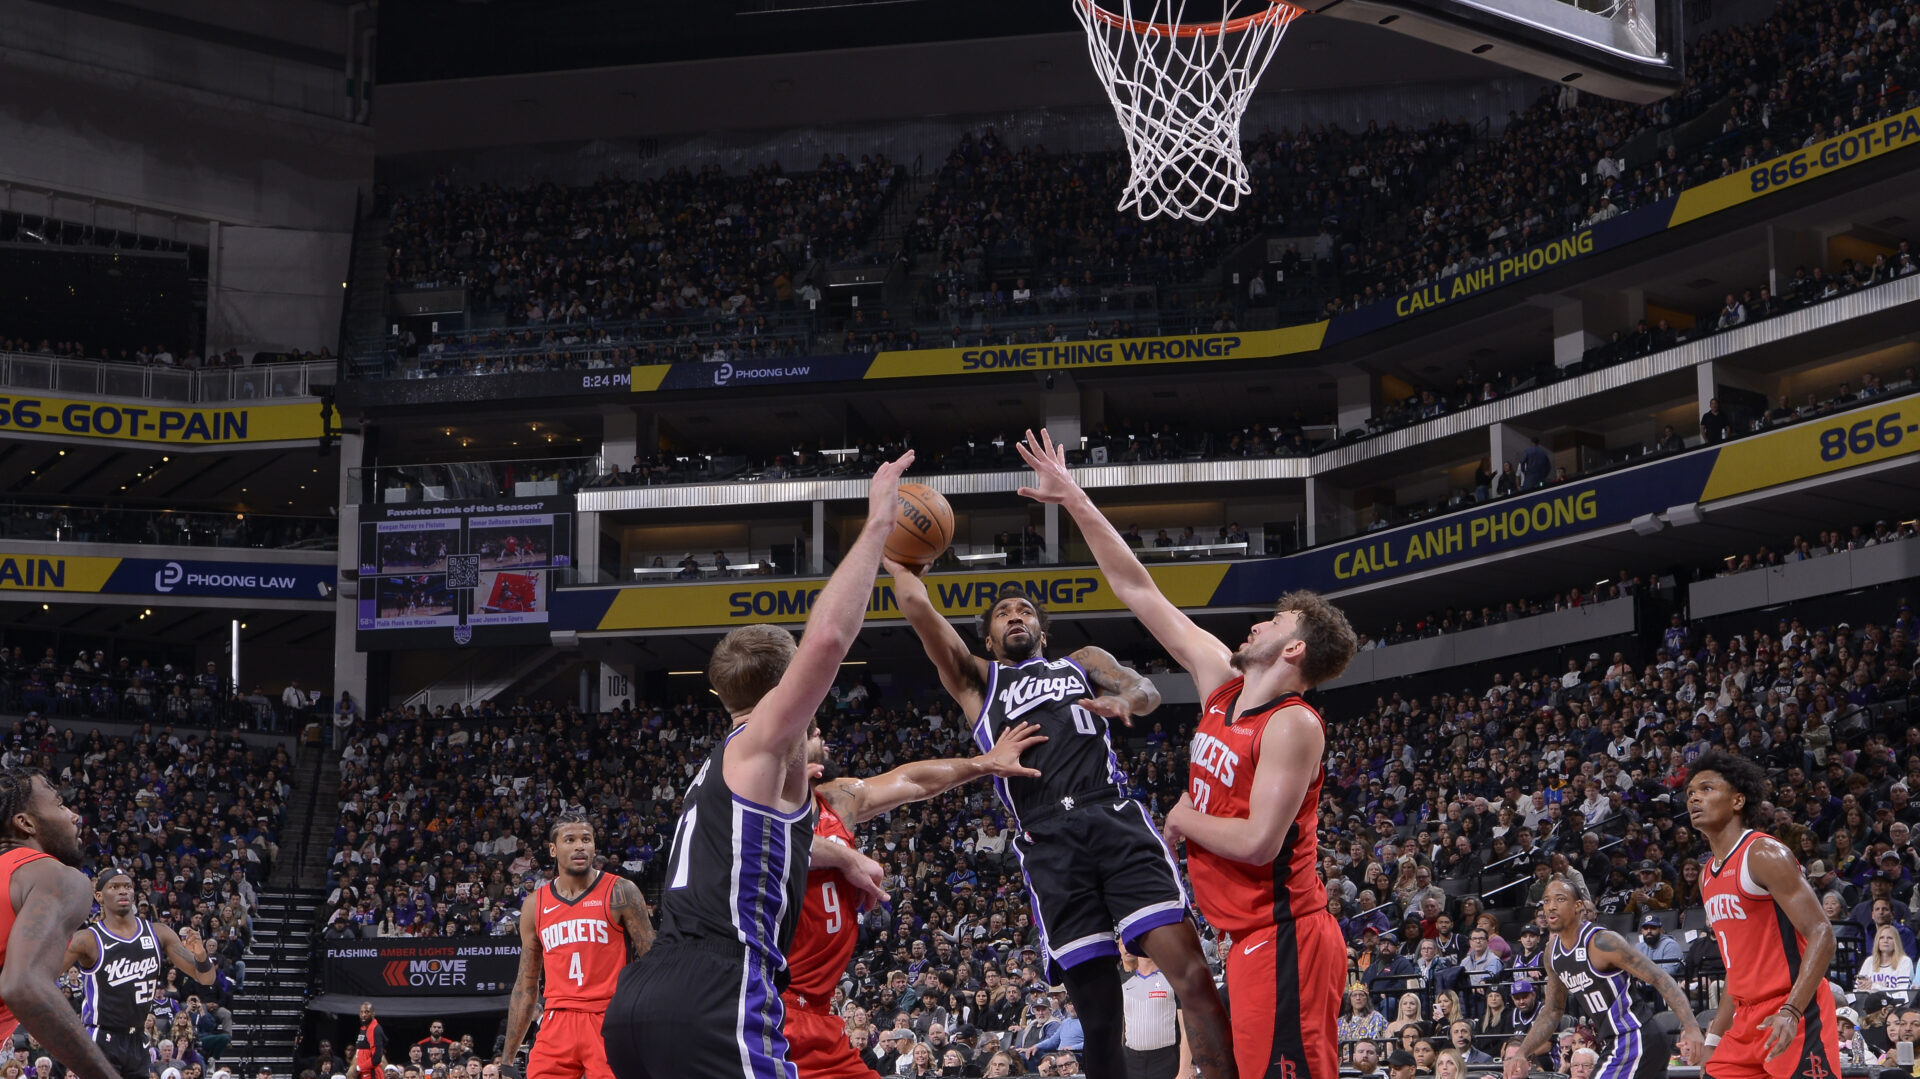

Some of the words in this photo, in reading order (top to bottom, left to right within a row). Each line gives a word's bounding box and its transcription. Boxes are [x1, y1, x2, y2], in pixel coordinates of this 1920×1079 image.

[1396, 285, 1446, 317] CALL
[1451, 265, 1494, 299] ANH
[1500, 230, 1593, 282] PHOONG
[962, 343, 1113, 370] SOMETHING
[1120, 336, 1241, 361] WRONG?
[582, 374, 609, 388] 8:24
[613, 373, 631, 386] PM
[736, 367, 783, 379] PHOONG
[785, 366, 811, 376] LAW
[387, 508, 432, 516] Favorite
[433, 506, 461, 514] Dunk
[463, 505, 476, 513] of
[476, 504, 494, 513] the
[496, 502, 544, 512] Season?
[898, 496, 932, 534] Wilso
[1334, 542, 1398, 580] CALL
[1405, 523, 1463, 564] ANH
[1470, 489, 1597, 548] PHOONG
[187, 574, 256, 587] PHOONG
[260, 576, 296, 589] LAW
[729, 584, 927, 617] SOMIN
[608, 675, 628, 697] 103
[999, 675, 1086, 720] Kings
[1070, 704, 1097, 735] 0
[821, 881, 842, 934] 9
[541, 918, 609, 953] ROCKETS
[1719, 931, 1731, 968] 1
[327, 949, 378, 958] FLASHING
[380, 948, 416, 957] AMBER
[419, 947, 455, 957] LIGHTS
[457, 946, 493, 956] AHEAD
[409, 959, 468, 973] MOVE
[104, 956, 158, 987] Kings
[409, 973, 467, 986] OVER
[568, 952, 584, 987] 4
[1559, 970, 1594, 994] Kings
[1869, 973, 1897, 988] INGS
[134, 979, 157, 1005] 23
[1584, 990, 1608, 1014] 10
